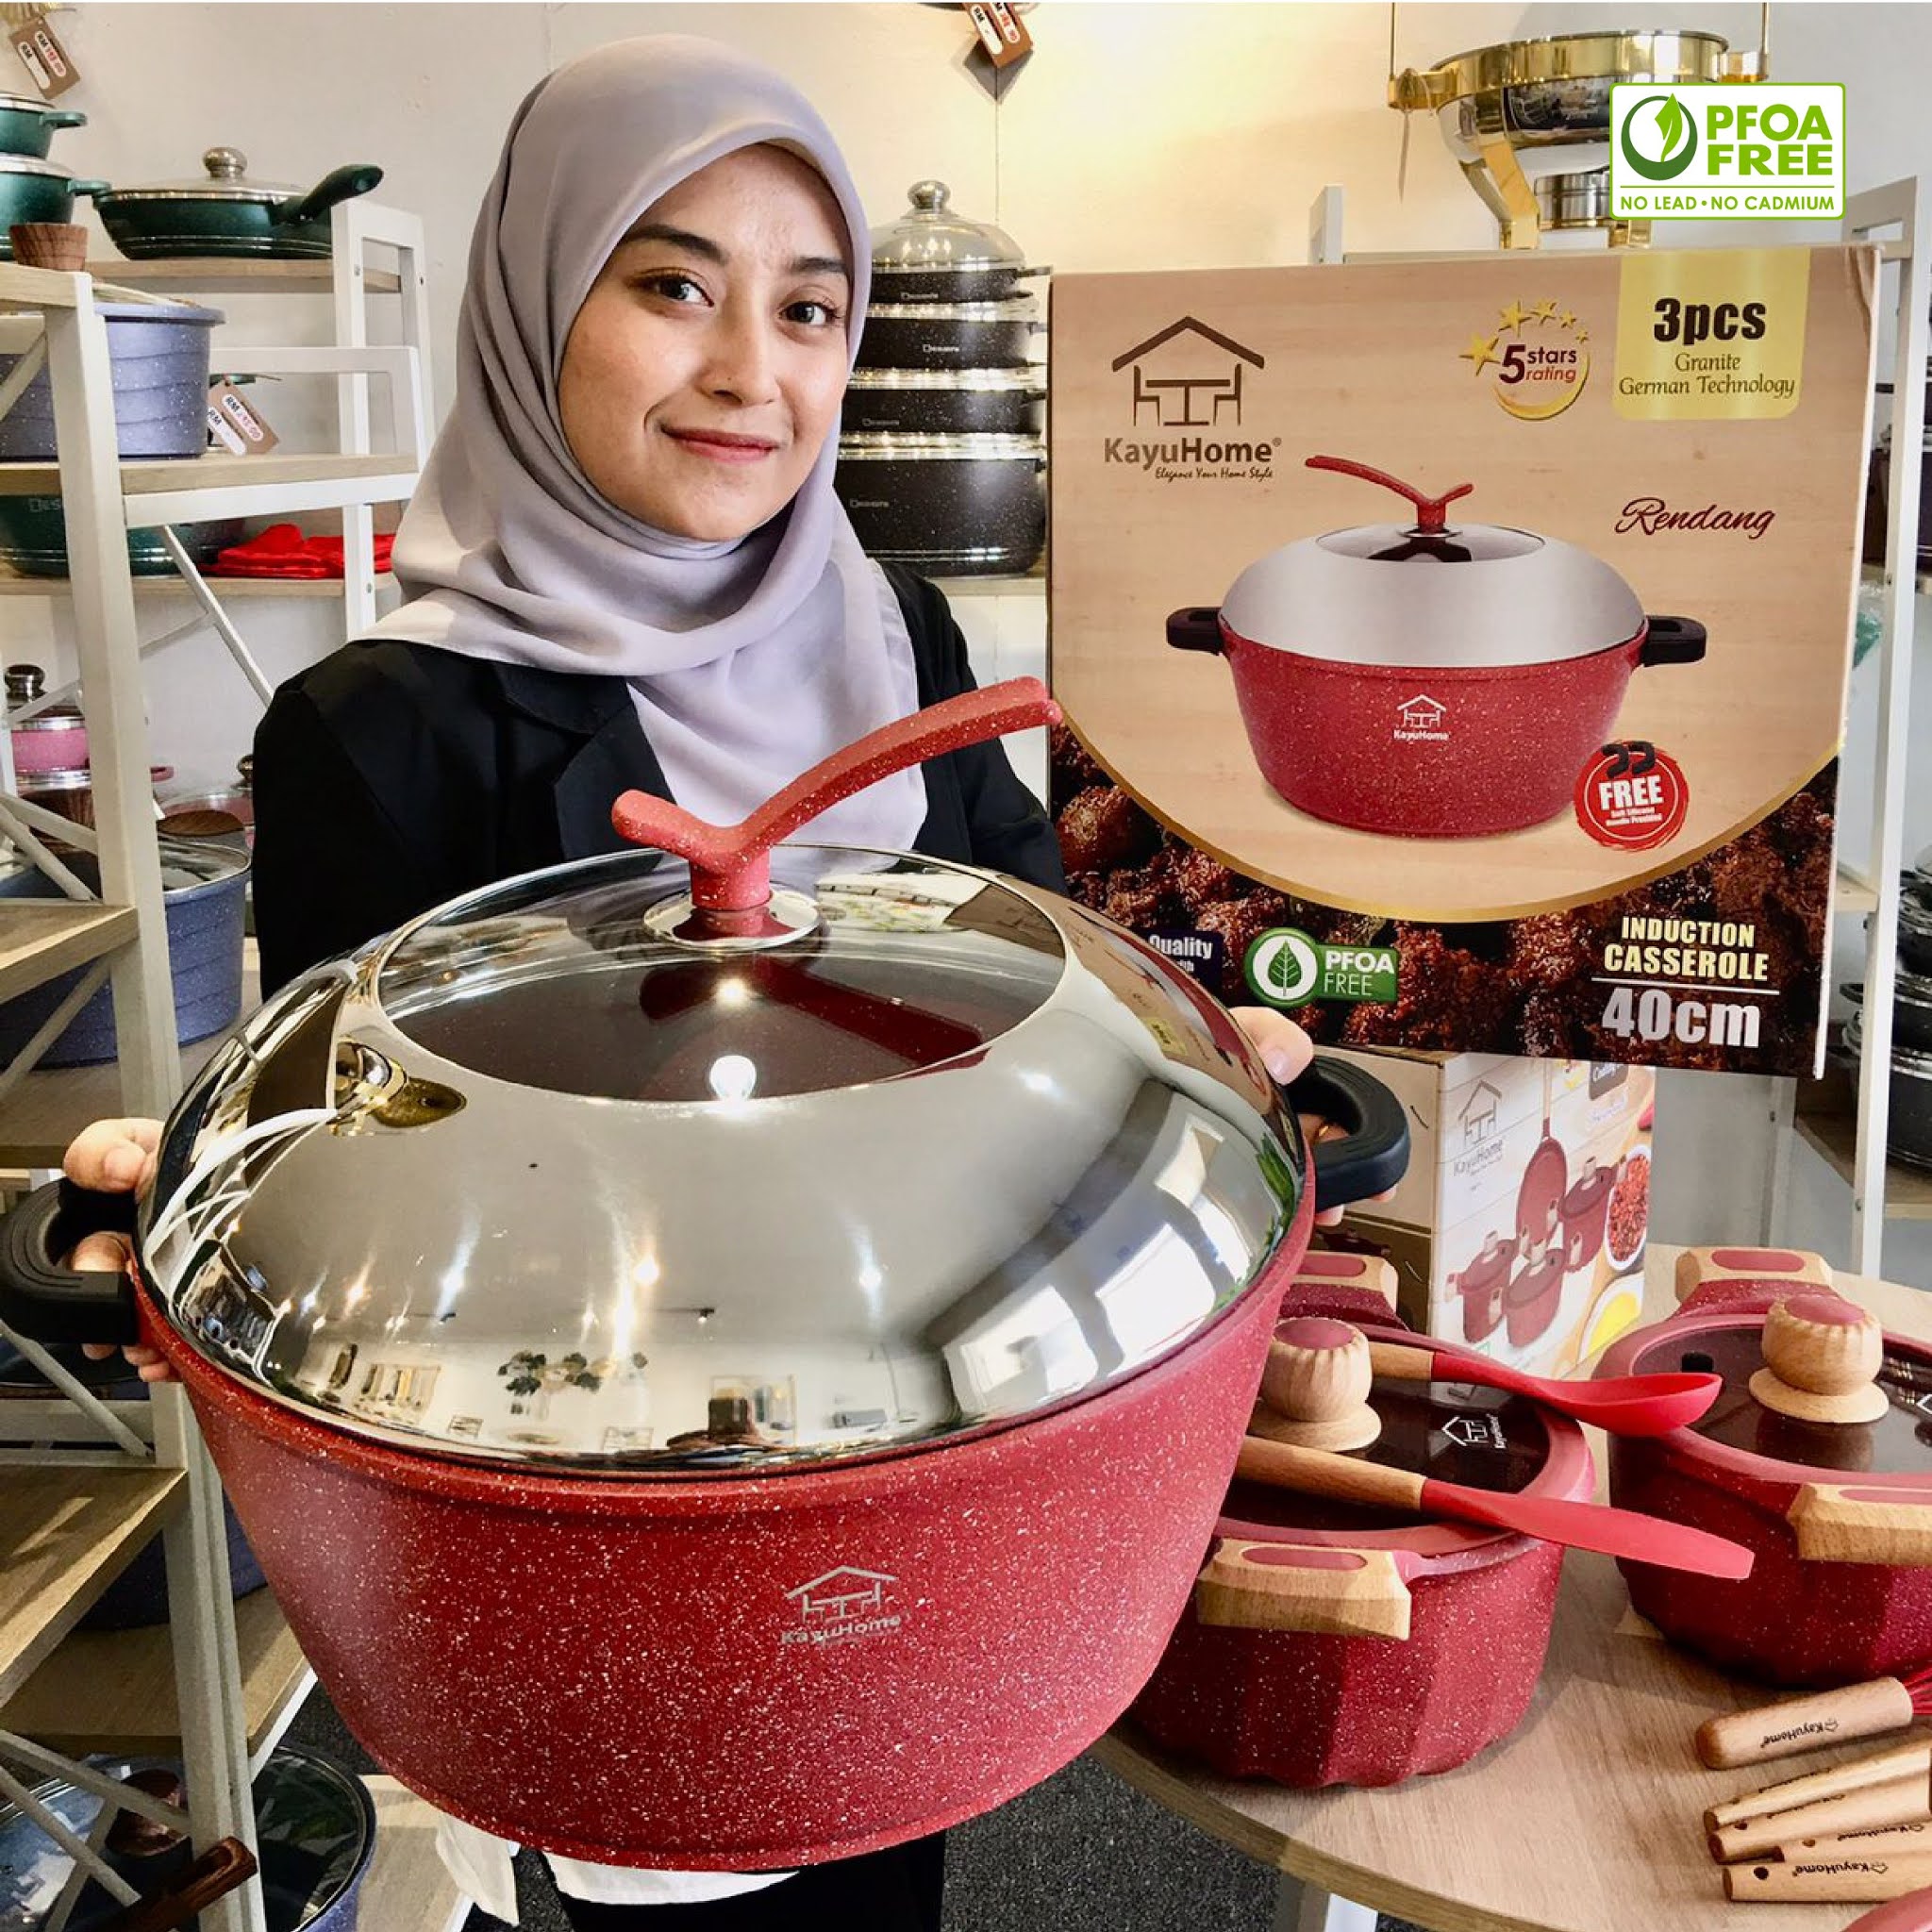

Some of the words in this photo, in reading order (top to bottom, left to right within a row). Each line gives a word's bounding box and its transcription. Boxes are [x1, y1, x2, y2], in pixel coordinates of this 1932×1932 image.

[1654, 297, 1767, 345] 3pcs
[1498, 343, 1526, 384] 5
[1527, 346, 1576, 364] stars
[1525, 366, 1576, 383] rating
[1674, 353, 1740, 372] Granite
[1619, 377, 1690, 395] German
[1697, 374, 1795, 399] Technology
[1196, 468, 1218, 478] Your
[1220, 467, 1246, 478] Home
[1249, 466, 1273, 482] Style
[1614, 496, 1775, 540] Rendang
[1598, 774, 1664, 811] FREE
[1621, 915, 1756, 949] INDUCTION
[1325, 950, 1395, 974] PFOA
[1604, 943, 1770, 981] CASSEROLE
[1324, 973, 1373, 995] FREE
[1602, 988, 1760, 1049] 40cm
